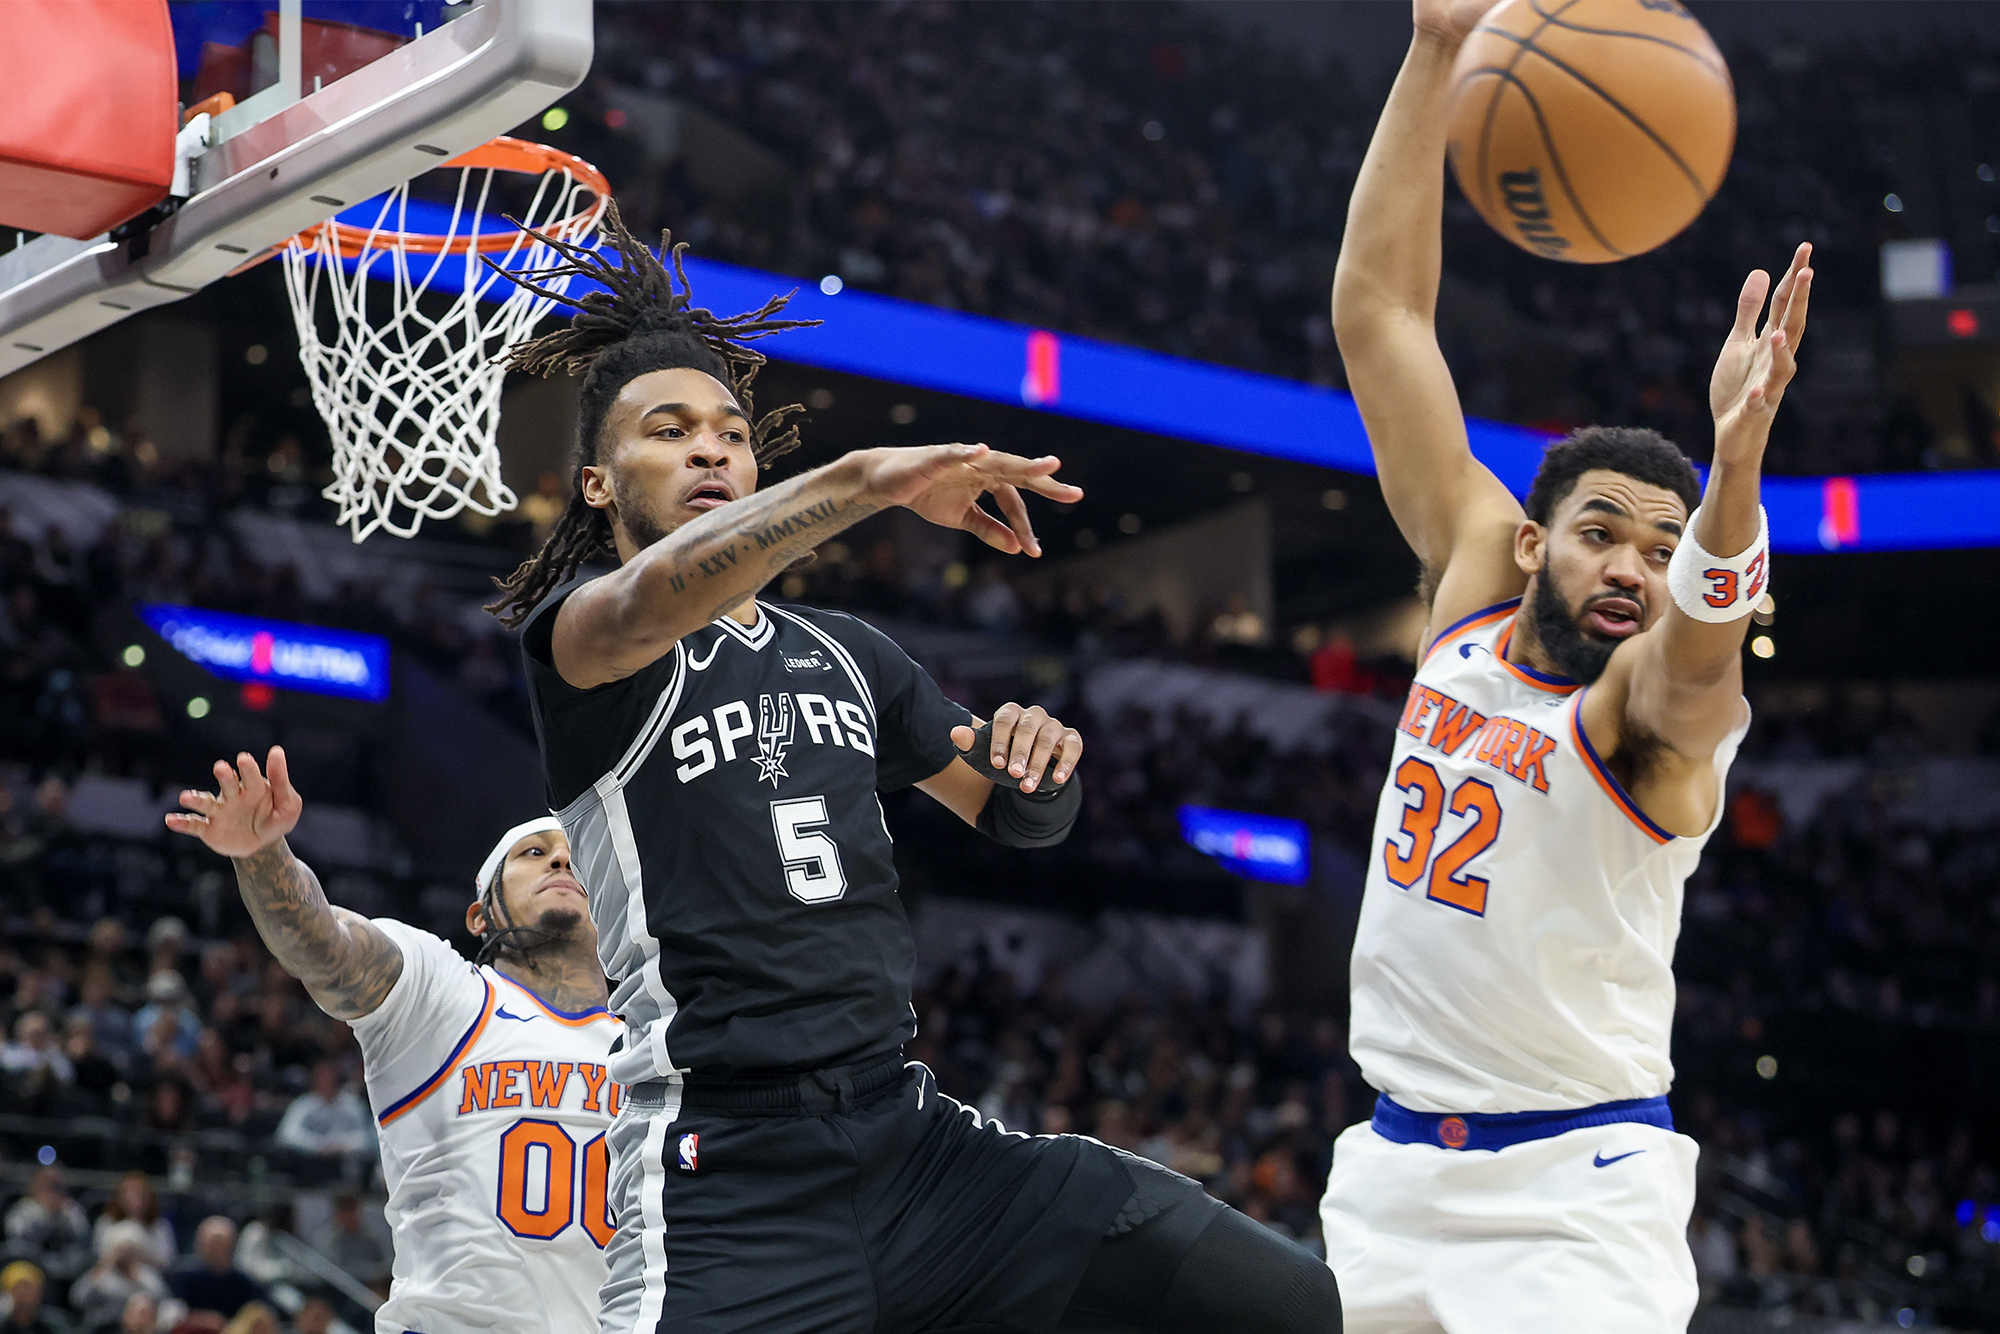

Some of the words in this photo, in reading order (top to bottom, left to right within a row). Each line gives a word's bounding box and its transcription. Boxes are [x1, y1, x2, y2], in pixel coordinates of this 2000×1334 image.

[697, 544, 738, 579] XXV
[754, 497, 840, 550] MMXXII
[1702, 547, 1767, 608] 32
[783, 657, 821, 669] LEDGER
[670, 691, 876, 790] SPURS
[769, 795, 848, 905] 5
[1384, 755, 1503, 917] 32
[458, 1060, 573, 1115] NEW
